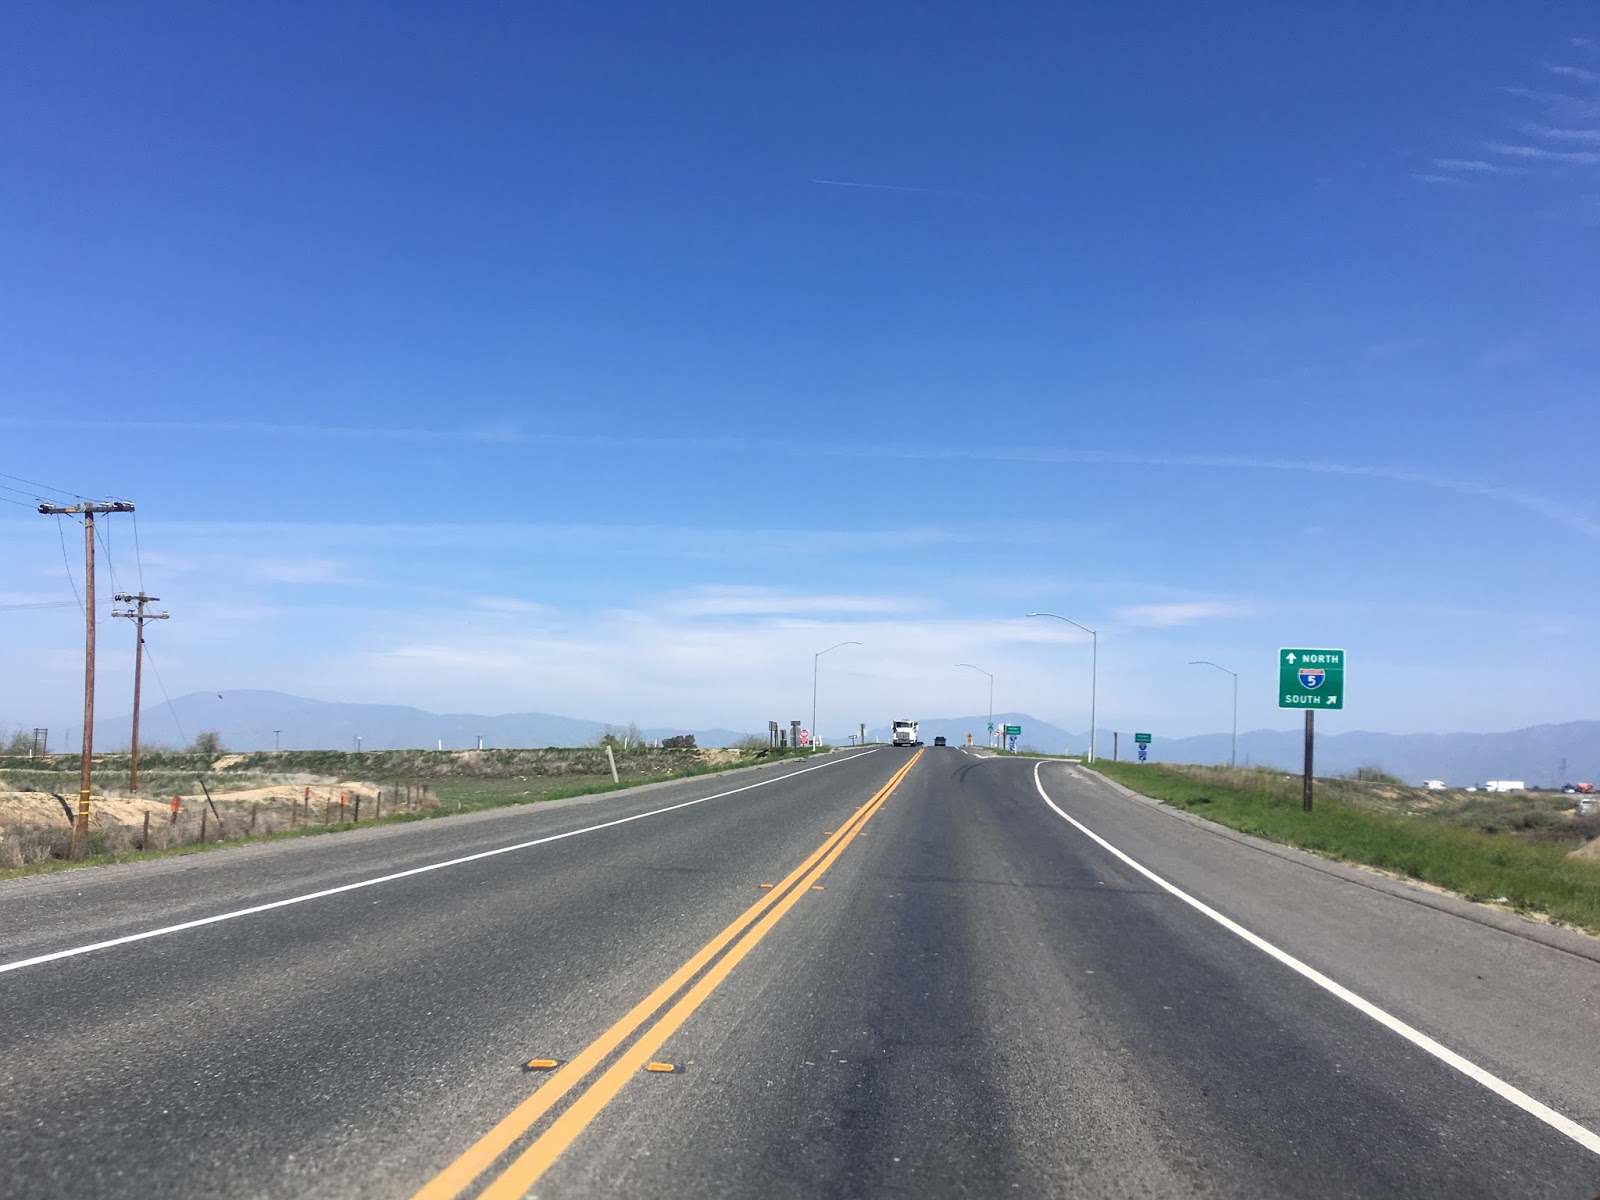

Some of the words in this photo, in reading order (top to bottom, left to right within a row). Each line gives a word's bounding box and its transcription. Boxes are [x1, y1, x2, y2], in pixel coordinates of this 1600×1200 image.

[1302, 654, 1339, 663] NORTH
[1307, 675, 1317, 687] 5
[1285, 694, 1321, 704] SOUTH
